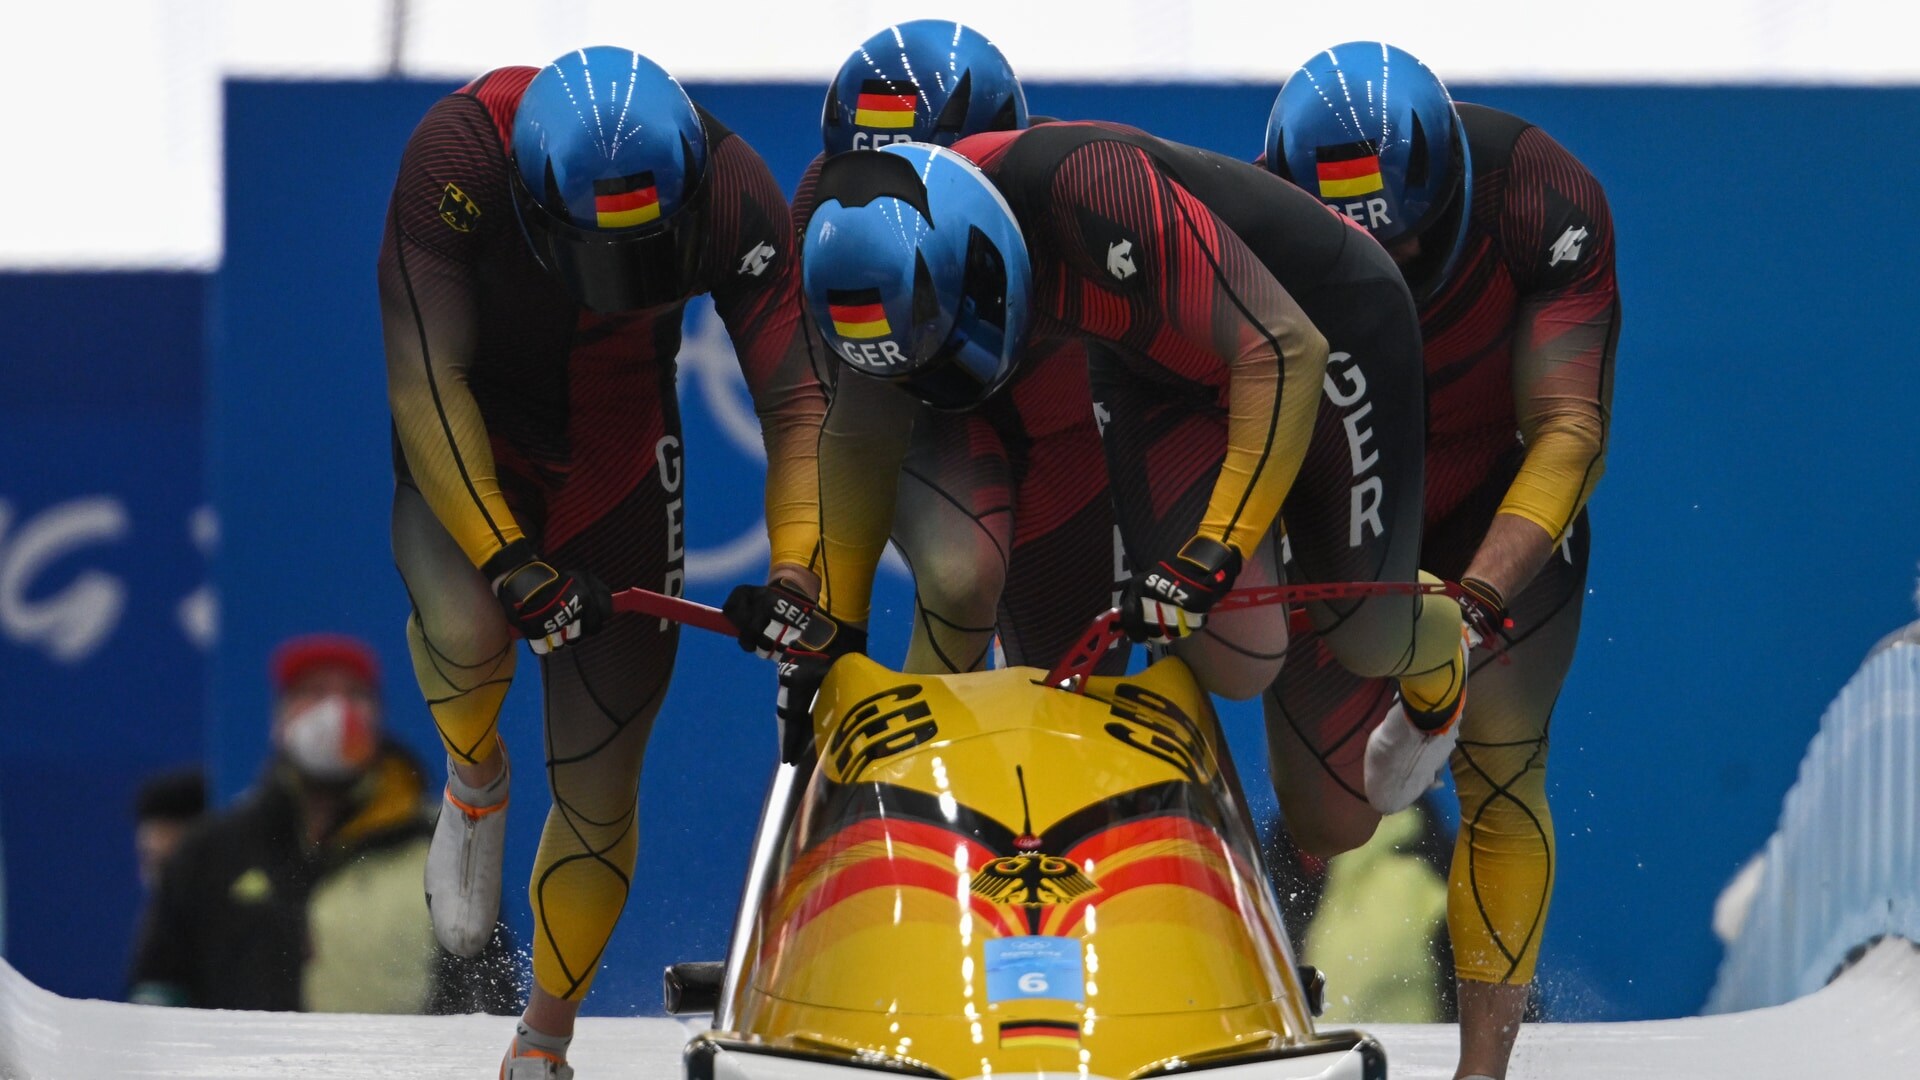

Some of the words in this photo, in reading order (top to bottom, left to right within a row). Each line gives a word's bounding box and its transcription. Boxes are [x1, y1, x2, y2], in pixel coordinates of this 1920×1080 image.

[1326, 198, 1392, 230] ER
[842, 340, 908, 367] GER
[1323, 351, 1385, 548] GER
[1017, 972, 1049, 993] 6
